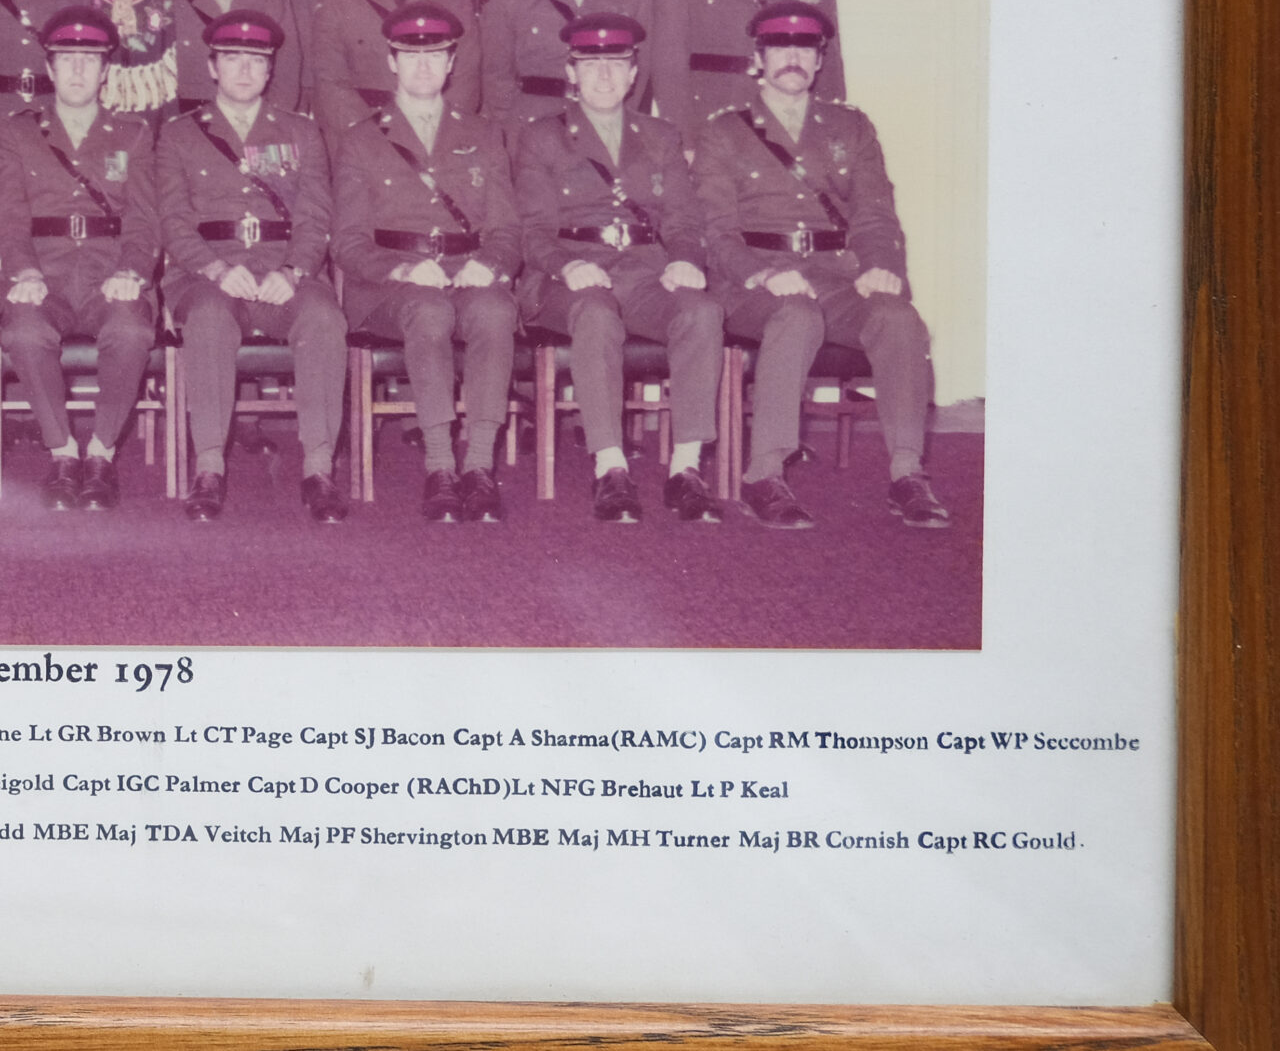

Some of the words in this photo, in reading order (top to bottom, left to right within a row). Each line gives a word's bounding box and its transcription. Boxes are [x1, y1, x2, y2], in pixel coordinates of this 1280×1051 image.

[114, 655, 194, 693] 1978
[28, 724, 53, 742] Lt
[57, 724, 94, 743] GR
[96, 725, 167, 744] Brown
[173, 725, 198, 743] Lt
[203, 725, 238, 744] CT
[241, 726, 293, 749] Page
[299, 726, 349, 750] Capt
[354, 727, 376, 750] SJ
[380, 727, 446, 747] Bacon
[452, 727, 504, 752] Capt
[508, 727, 527, 747] A
[713, 730, 764, 754] Capt
[767, 730, 811, 749] RM
[814, 730, 929, 755] Thompson
[936, 731, 987, 755] Capt
[990, 731, 1029, 750] WP
[62, 773, 112, 797] Capt
[116, 774, 160, 792] IGC
[164, 774, 241, 794] Palmer
[247, 775, 297, 799] Capt
[299, 776, 319, 794] D
[324, 776, 400, 800] Cooper
[540, 778, 596, 797] NFG
[600, 779, 684, 799] Brehaut
[690, 779, 715, 799] Lt
[719, 780, 735, 799] P
[739, 780, 789, 799] Keal
[32, 822, 90, 841] MBE
[95, 823, 137, 847] Maj
[144, 823, 199, 843] TDA
[203, 824, 273, 844] Veitch
[278, 825, 321, 850] Maj
[325, 826, 356, 845] PF
[360, 826, 488, 850] Shervington
[491, 827, 550, 847] MBE
[557, 828, 600, 852] Maj
[605, 828, 651, 847] MH
[654, 829, 731, 849] Turner
[738, 830, 780, 854] Maj
[785, 830, 821, 849] BR
[825, 830, 910, 850] Cornish
[917, 830, 968, 855] Capt
[972, 830, 1007, 850] RC
